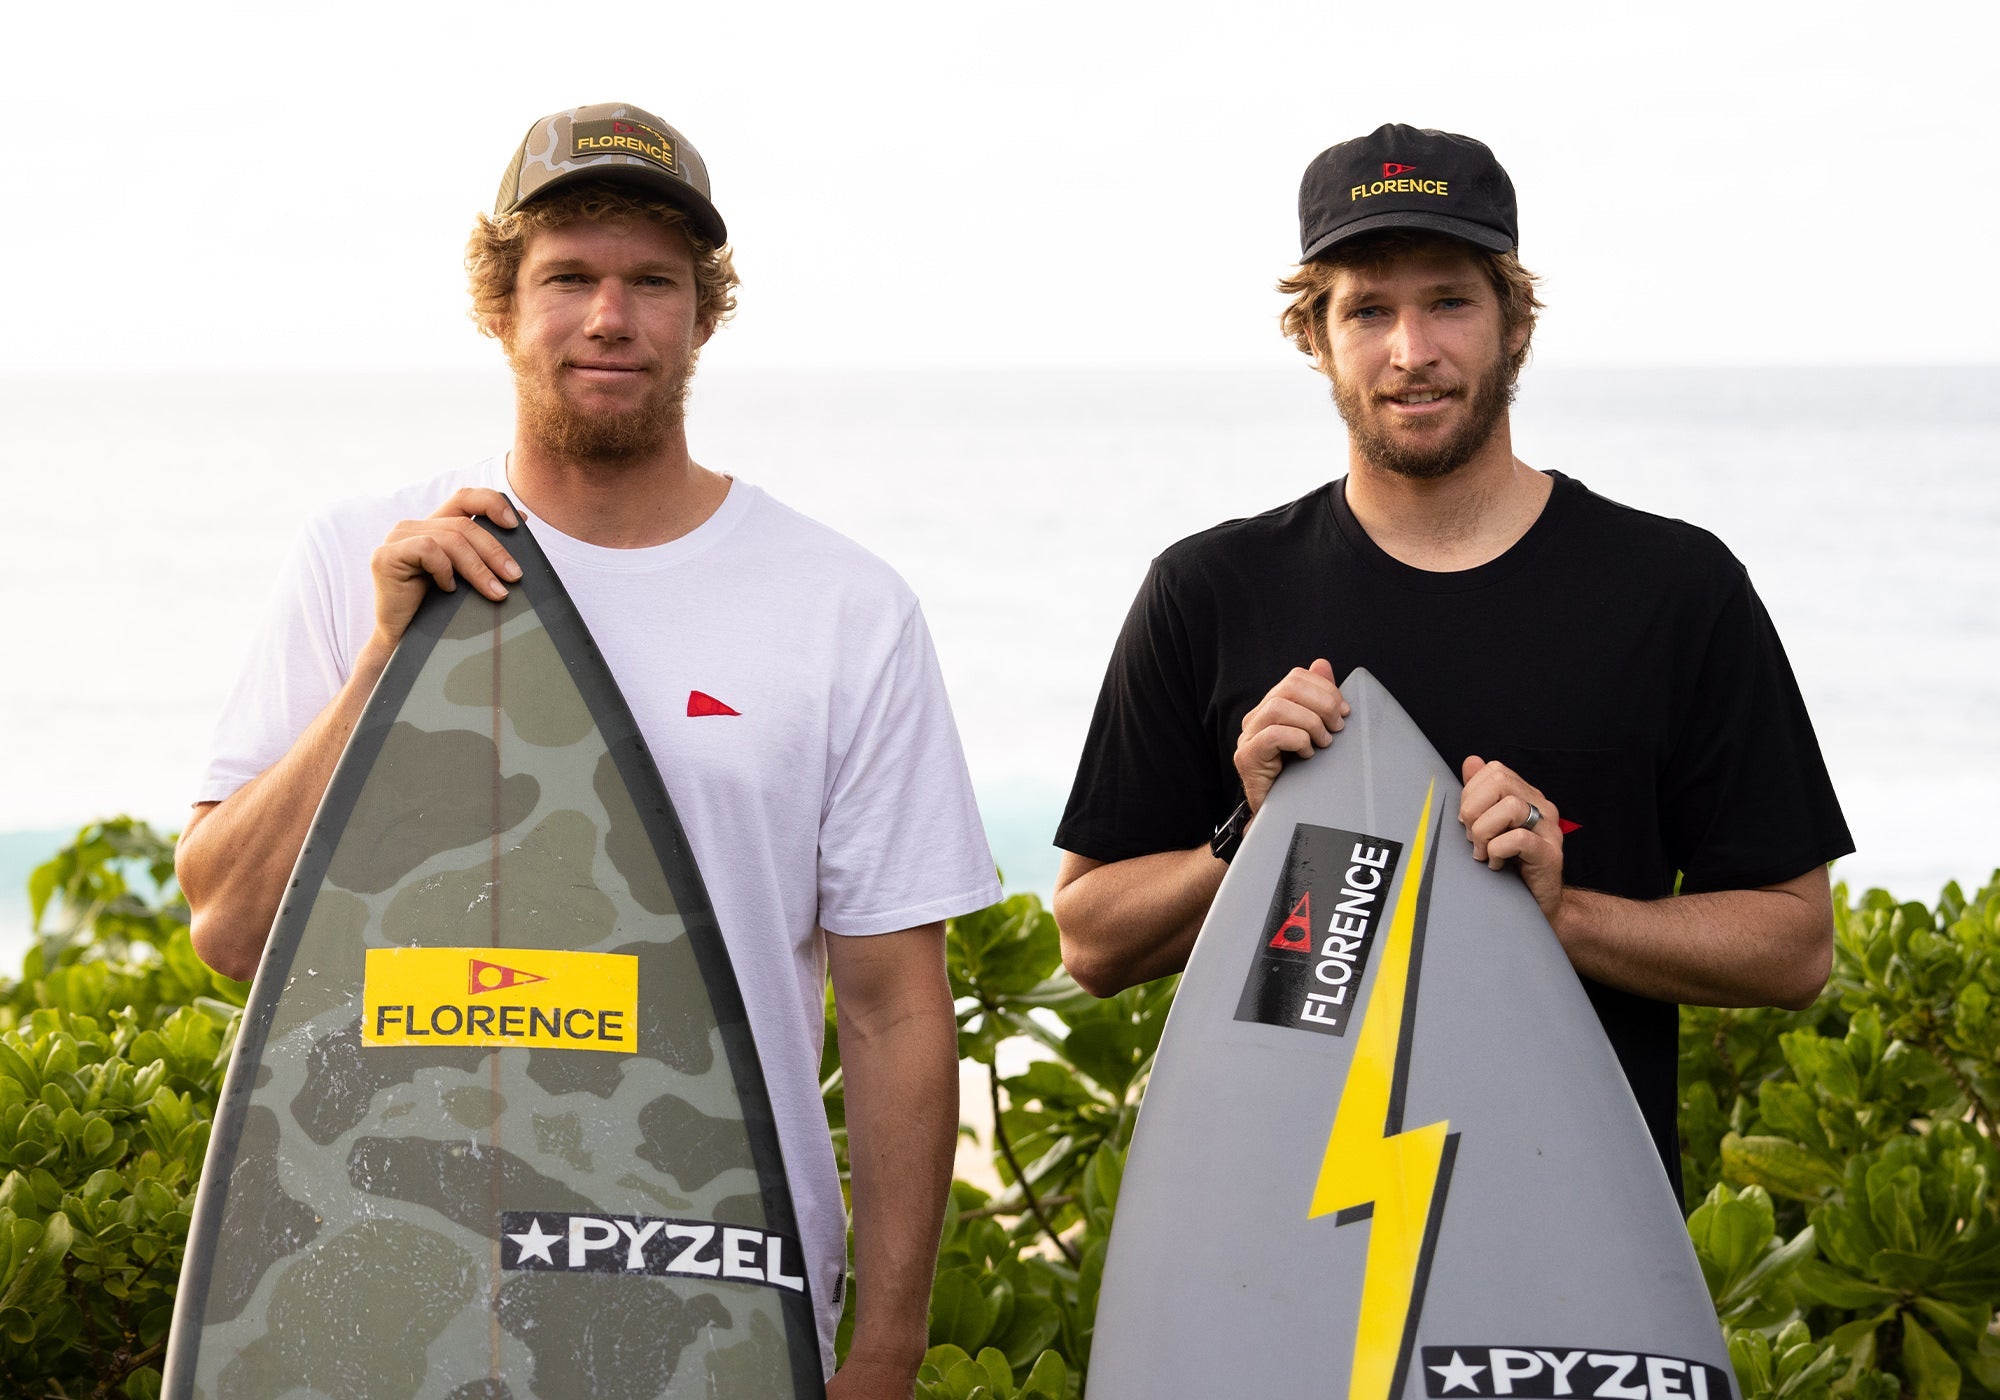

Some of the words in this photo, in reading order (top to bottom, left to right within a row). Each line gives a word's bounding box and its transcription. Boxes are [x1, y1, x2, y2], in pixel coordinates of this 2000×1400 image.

[577, 135, 673, 166] FLORENCE
[1351, 178, 1449, 202] FLORENCE
[1300, 842, 1390, 1026] FLORENCE
[376, 1004, 624, 1042] FLORENCE
[568, 1216, 805, 1293] PYZEL
